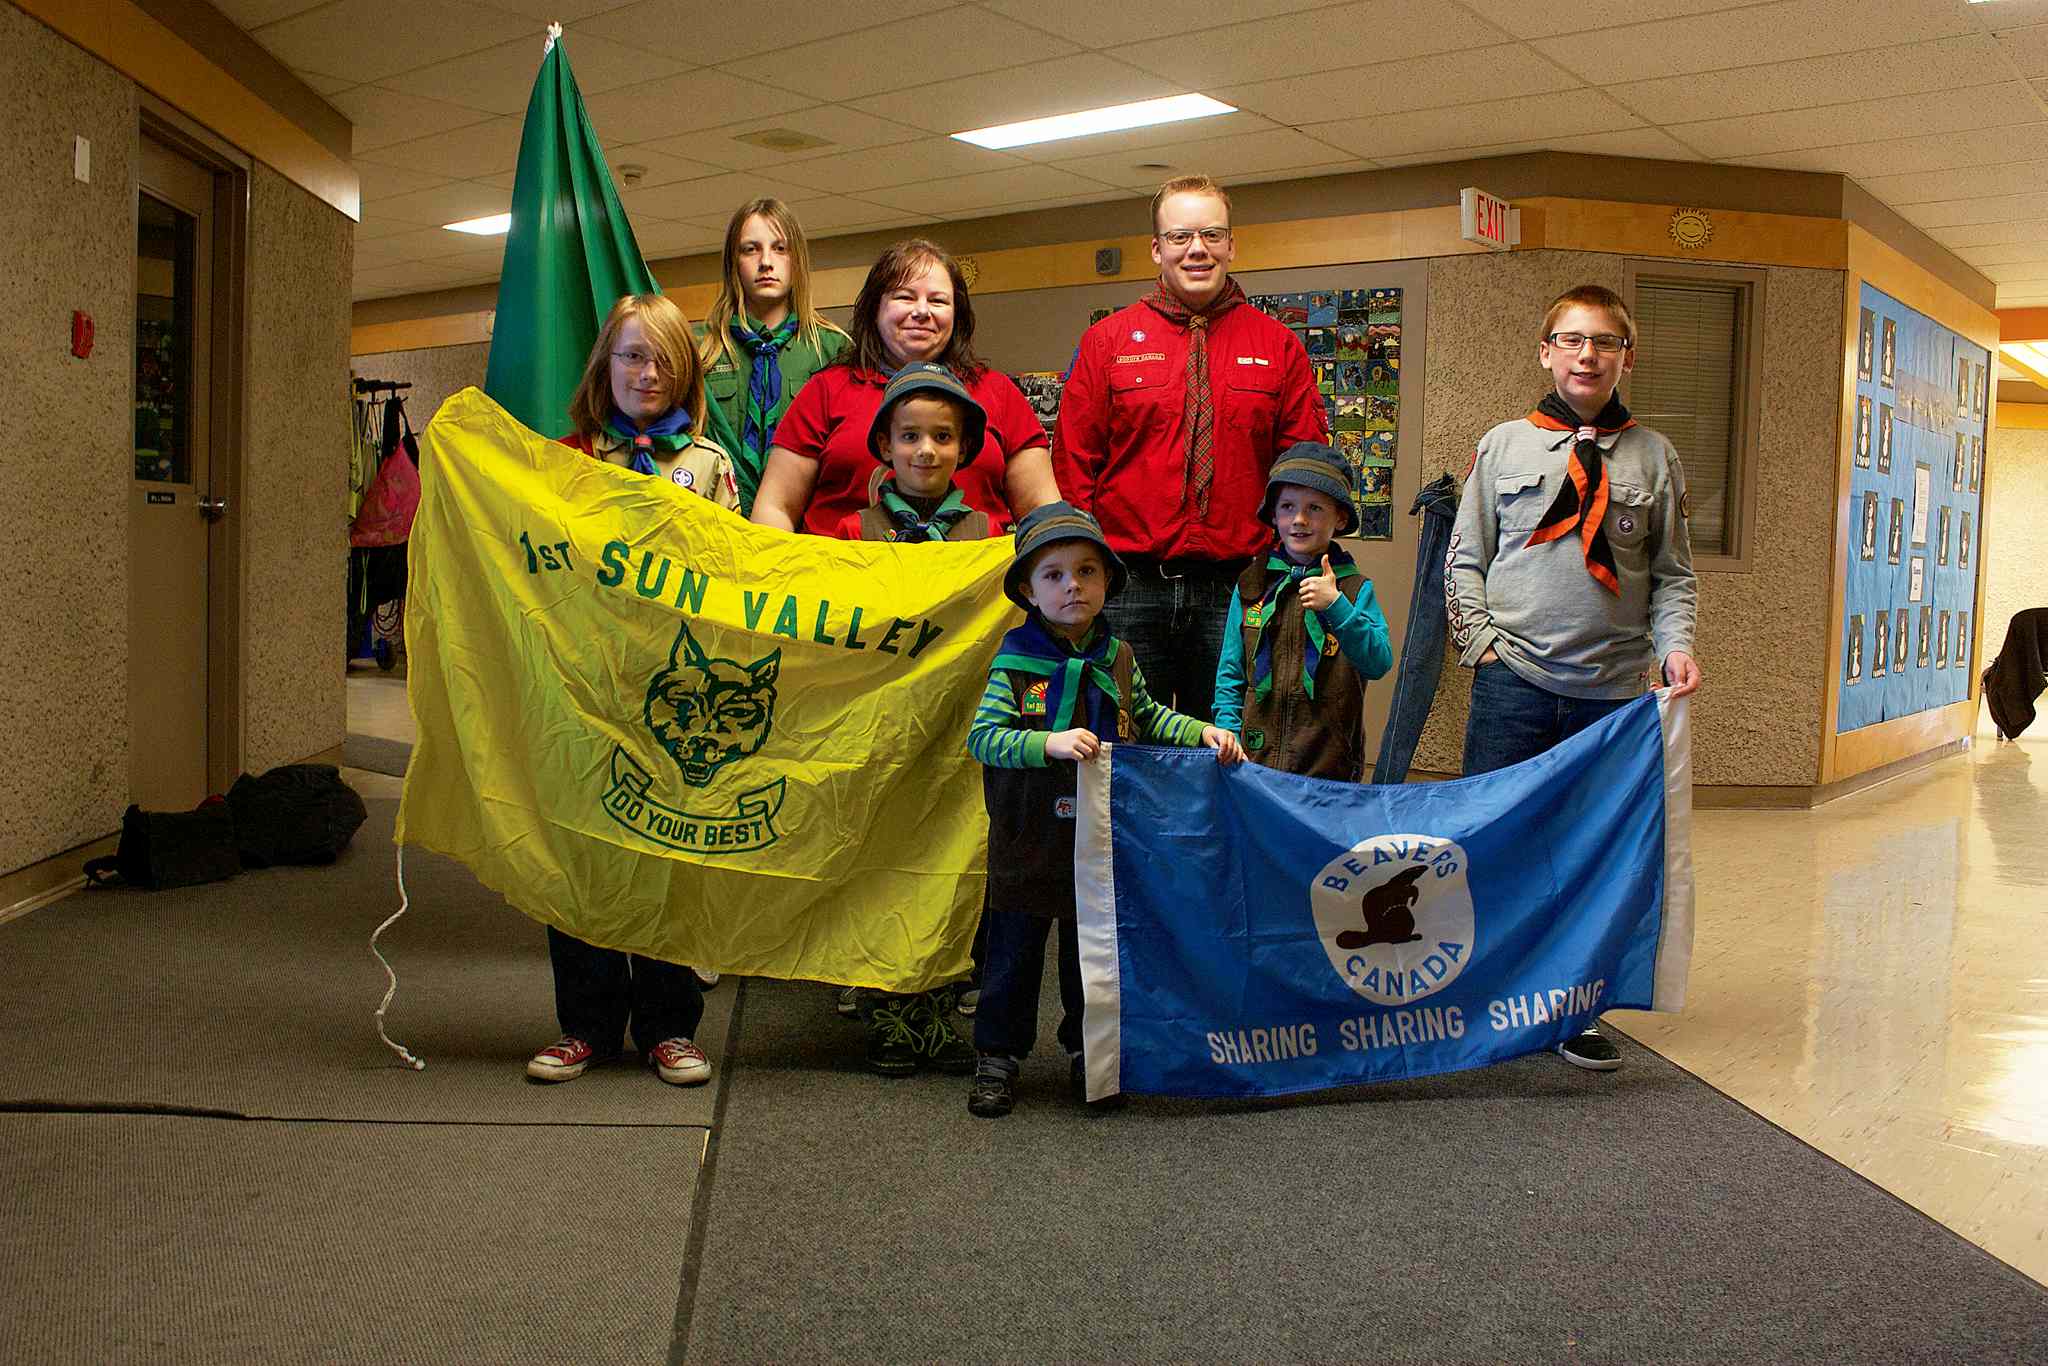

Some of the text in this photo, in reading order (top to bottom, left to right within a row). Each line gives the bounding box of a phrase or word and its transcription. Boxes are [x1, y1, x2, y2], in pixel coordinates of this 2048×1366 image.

[1477, 194, 1506, 244] EXIT
[519, 531, 943, 658] 1ST SUN VALLEY
[612, 792, 763, 846] DO YOUR BEST
[1322, 839, 1459, 892] BEAVERS
[1346, 938, 1464, 998] CANADA
[1207, 978, 1605, 1065] SHARING SHARING SHARING
